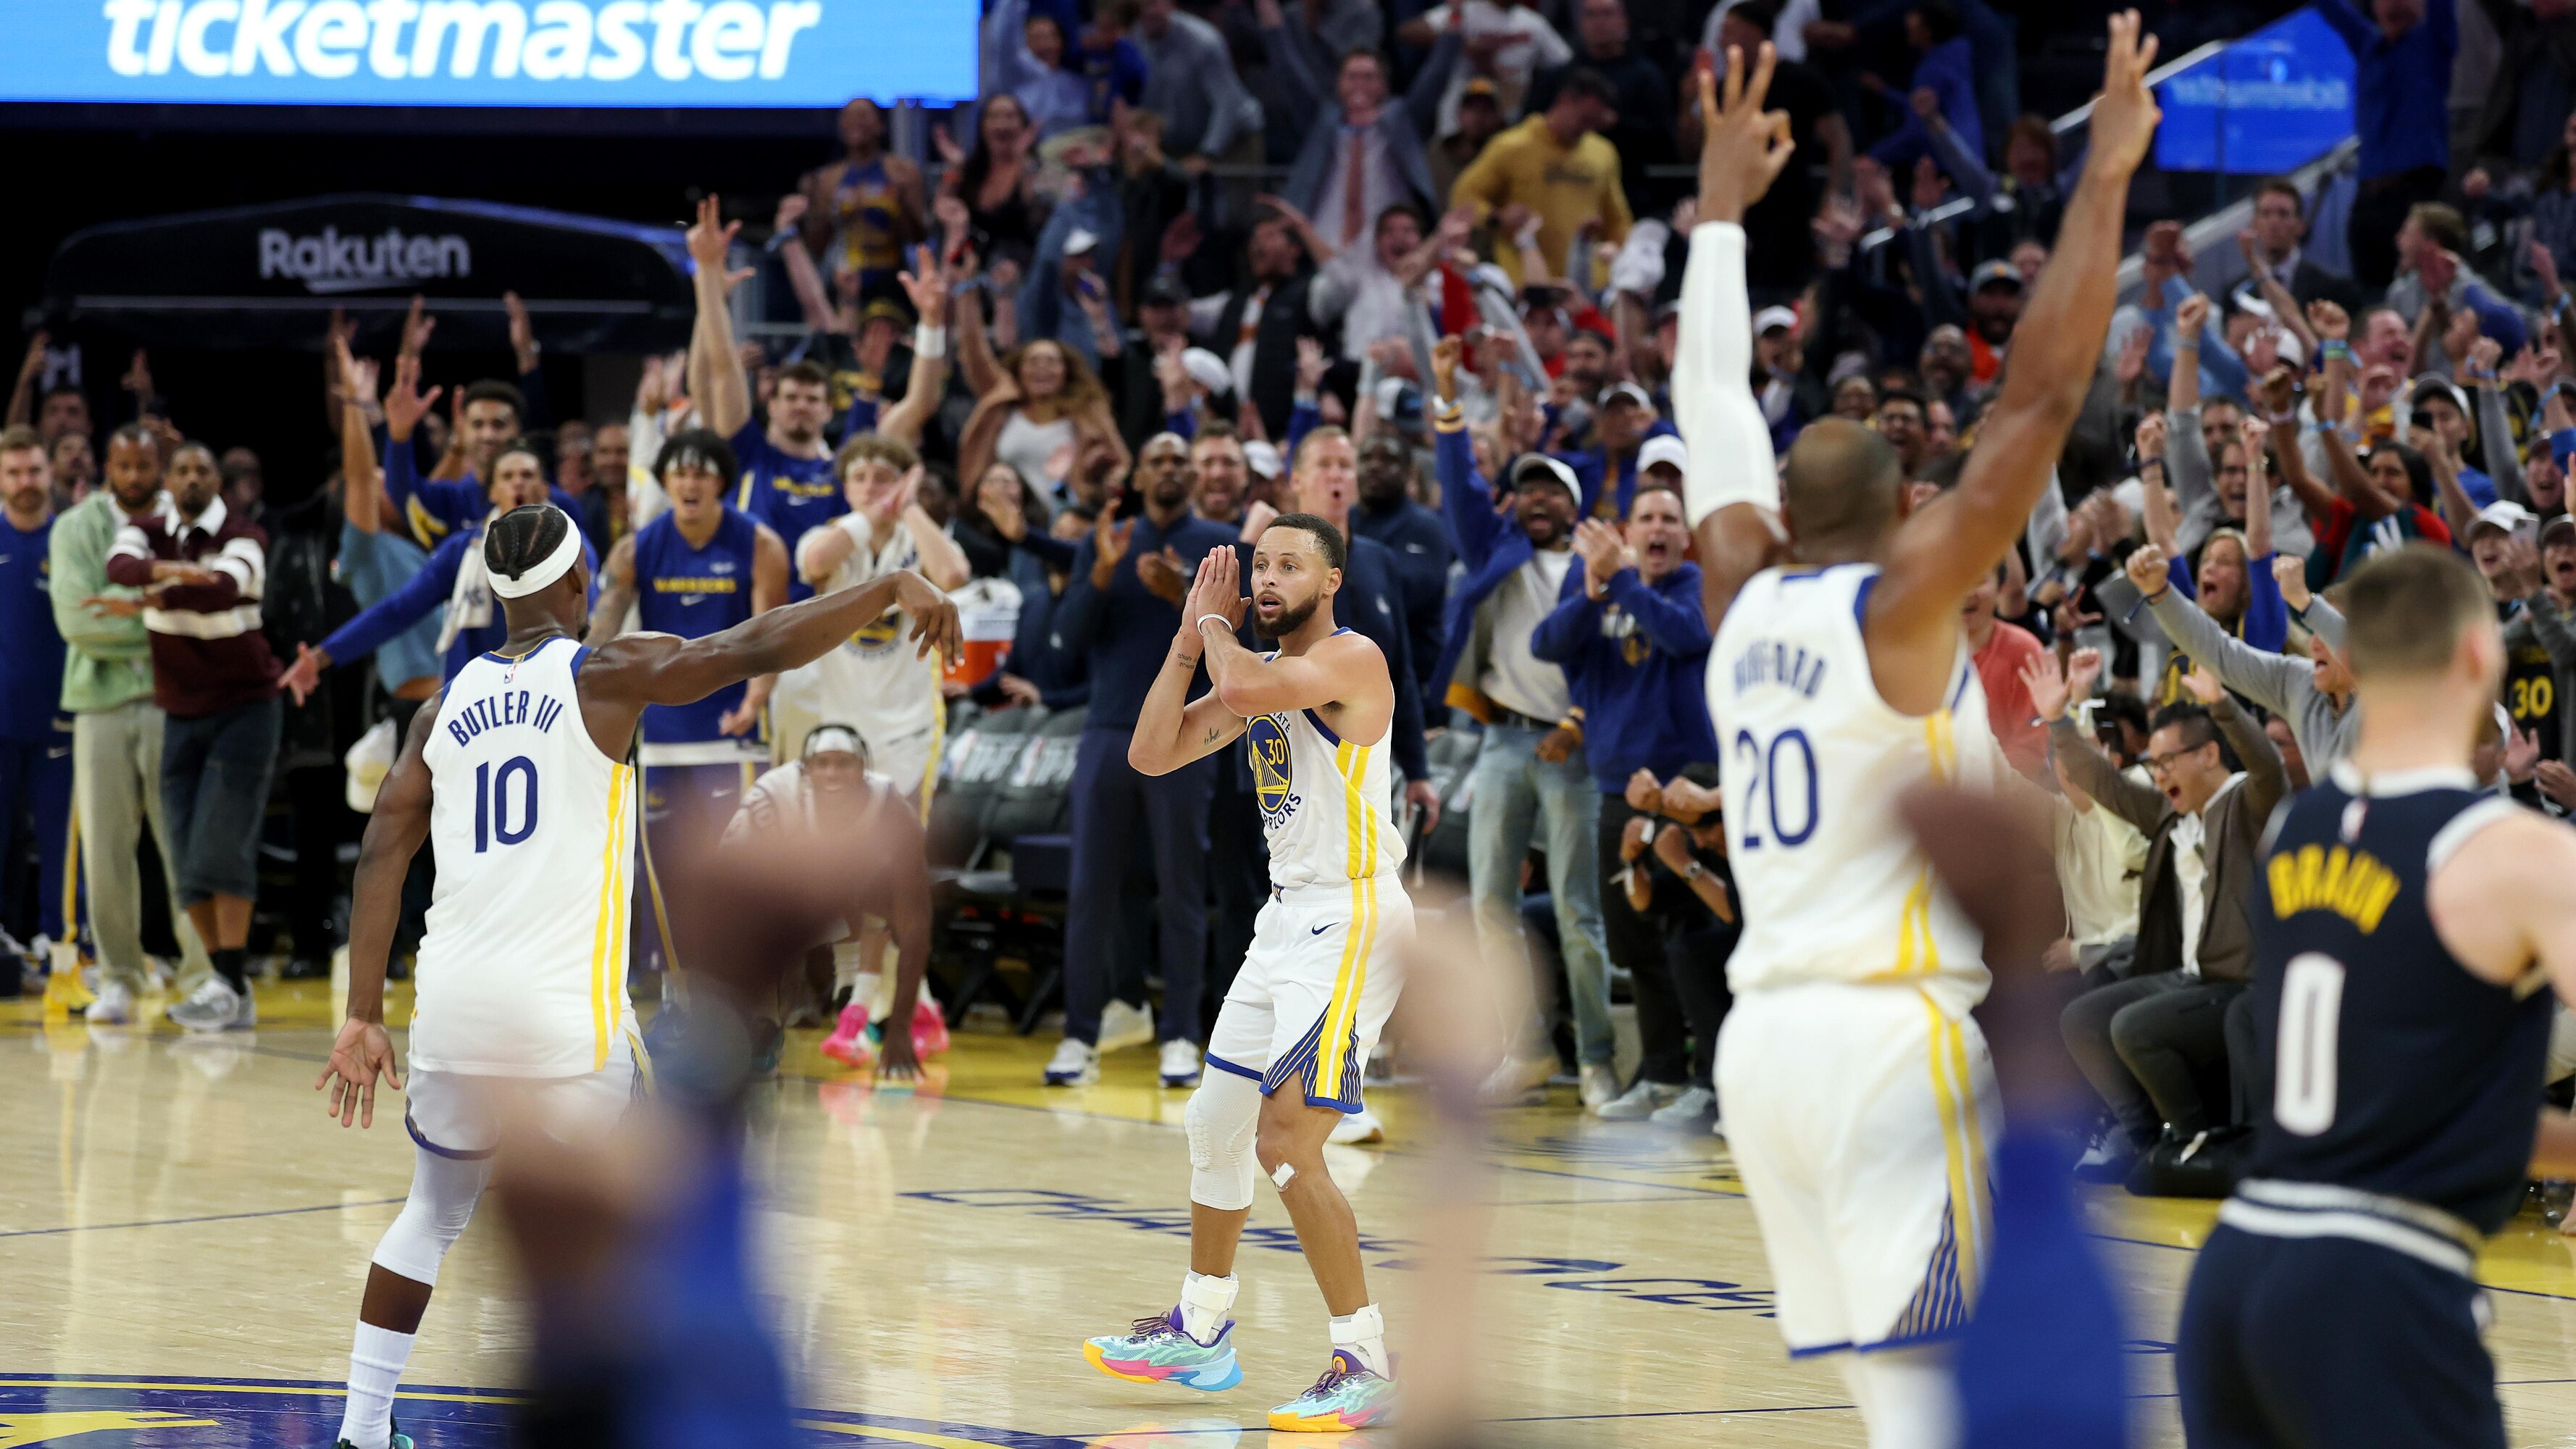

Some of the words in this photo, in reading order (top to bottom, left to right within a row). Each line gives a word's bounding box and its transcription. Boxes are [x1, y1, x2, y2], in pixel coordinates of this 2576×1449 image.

[104, 0, 820, 81] ticketmaster
[259, 225, 471, 280] Rakuten
[448, 690, 530, 748] BUTLER
[533, 695, 563, 734] III
[2512, 675, 2554, 719] 30
[1265, 738, 1285, 765] 30
[475, 756, 538, 853] 10
[1263, 793, 1302, 830] RRIORS
[1736, 727, 1819, 850] 20
[2273, 951, 2346, 1137] 0
